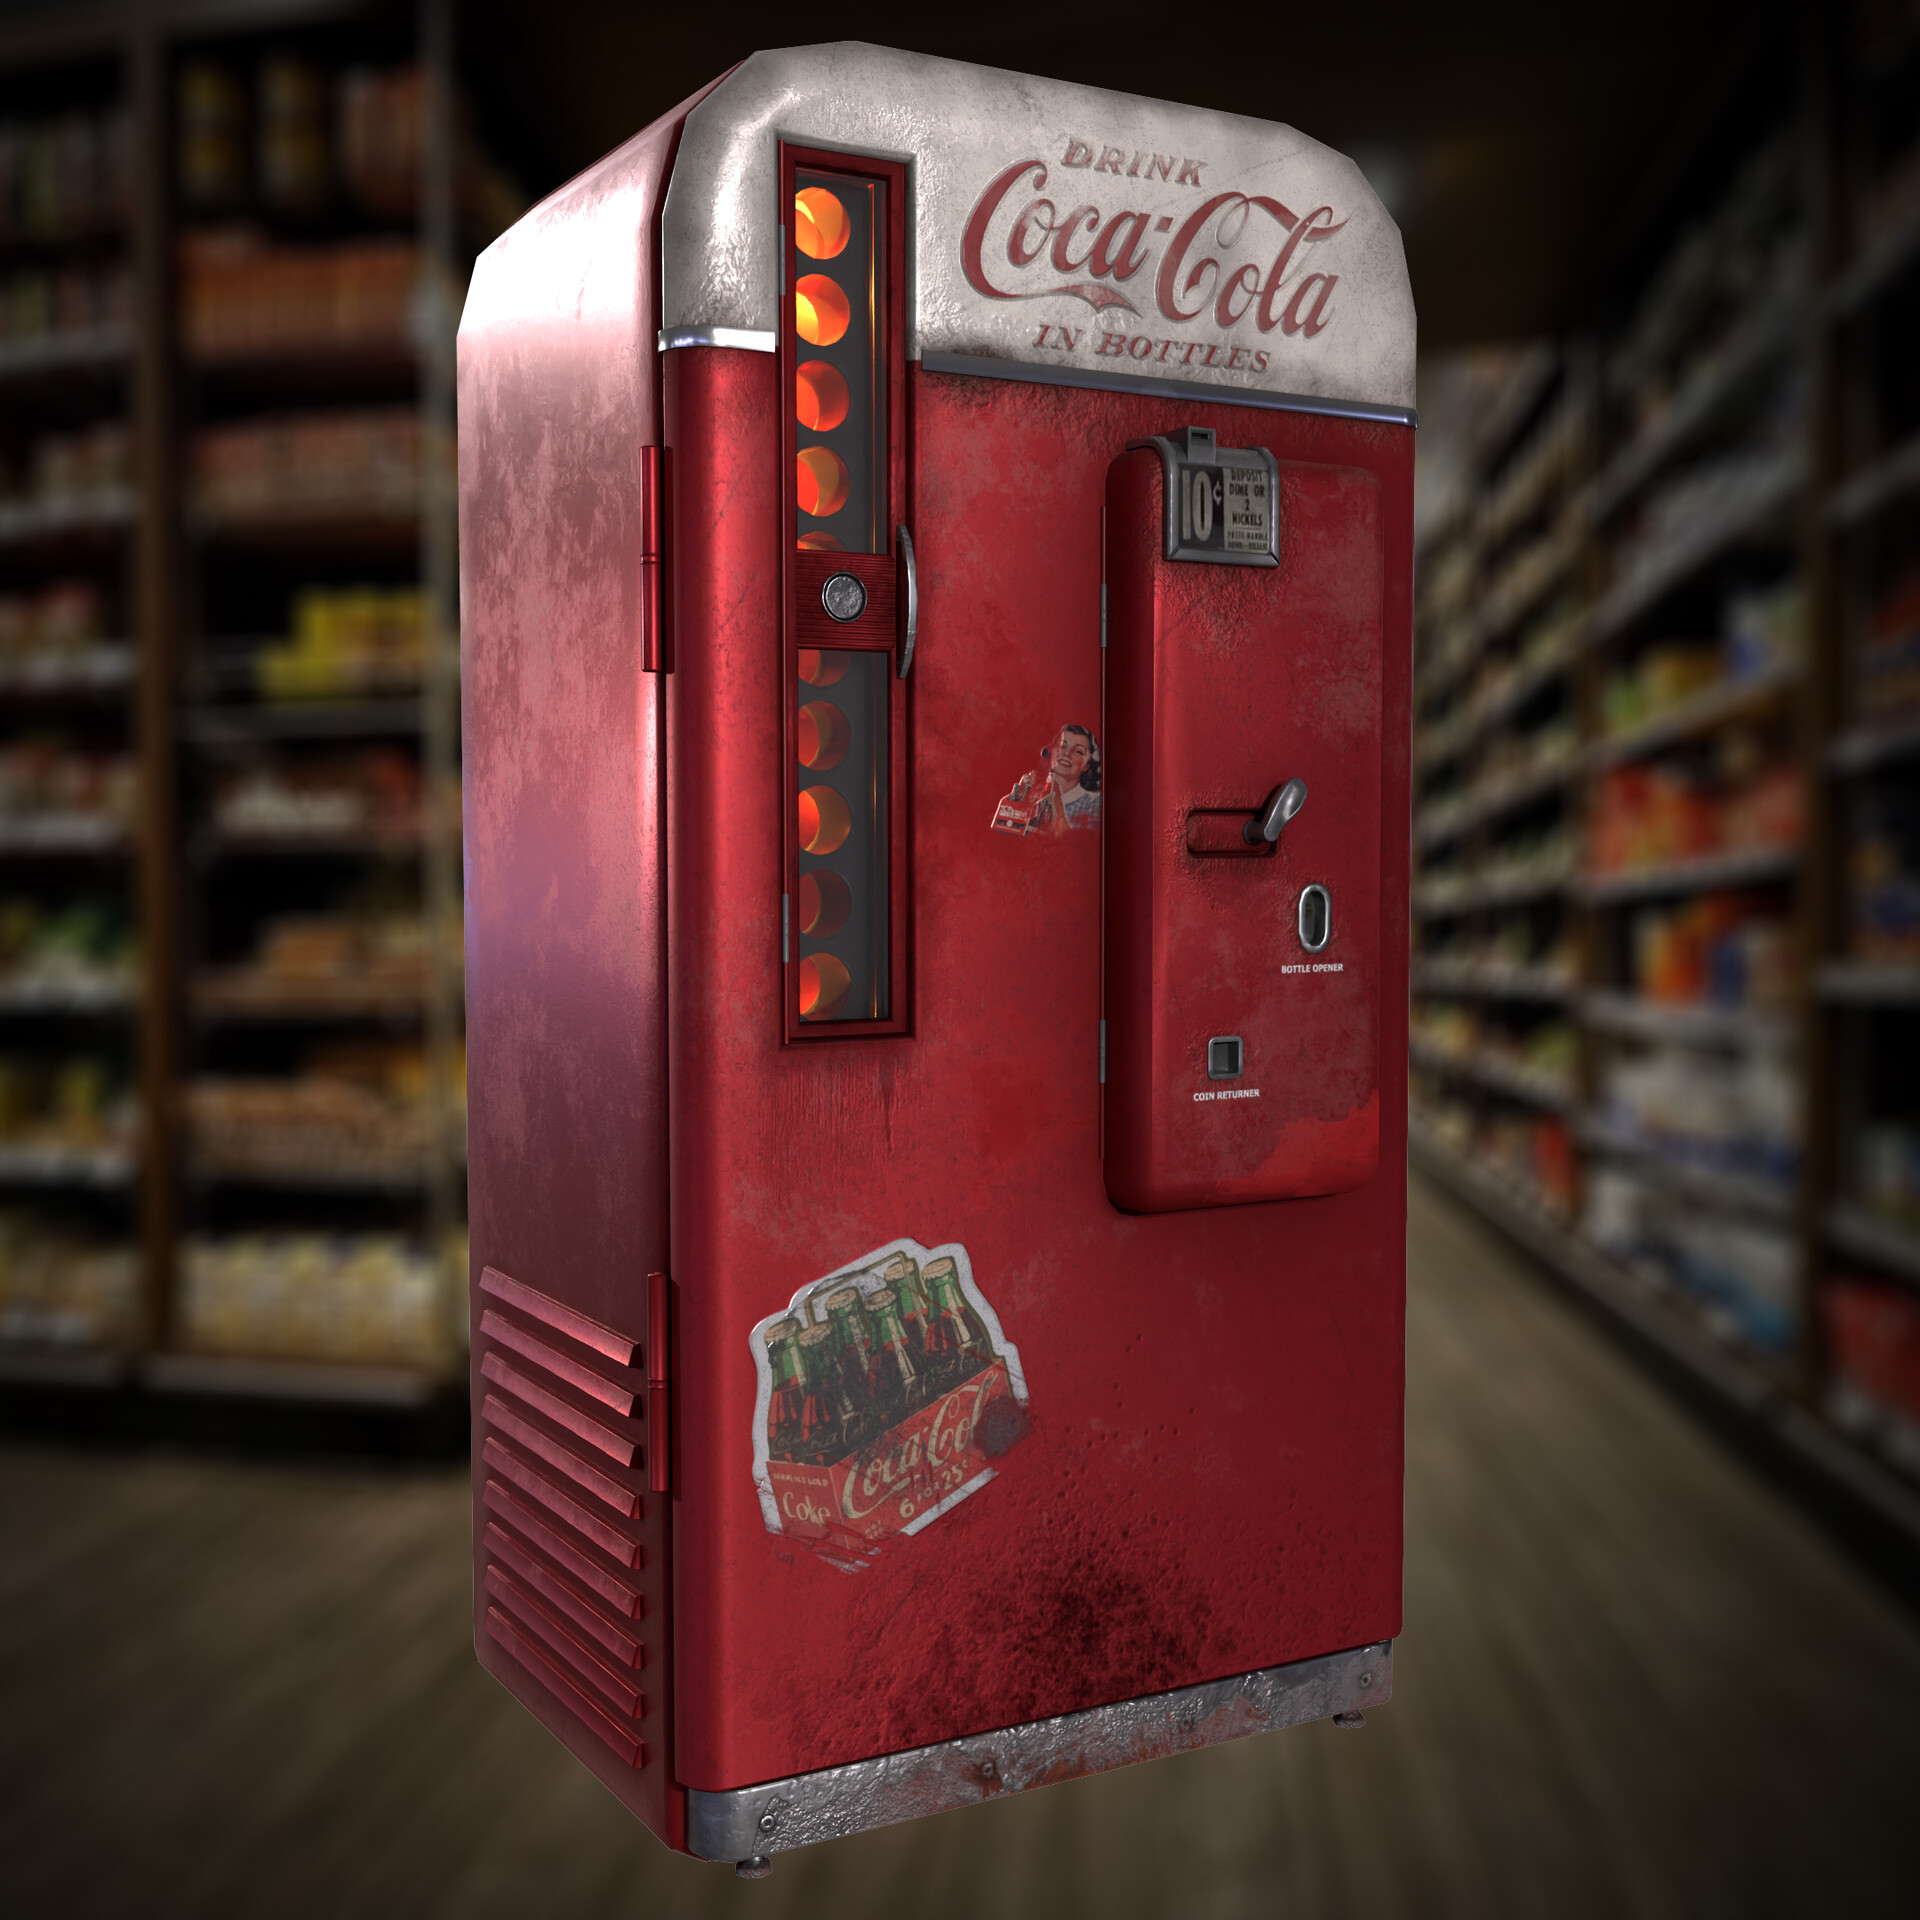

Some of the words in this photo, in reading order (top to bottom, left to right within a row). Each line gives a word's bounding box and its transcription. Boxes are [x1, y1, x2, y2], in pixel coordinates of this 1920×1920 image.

[1060, 138, 1208, 187] DRINK
[960, 159, 1356, 339] Coca-Cola
[1032, 324, 1083, 352] IN
[1095, 330, 1272, 374] BOTTLES
[1231, 468, 1263, 482] DEPOSIT
[1229, 483, 1249, 497] DIME
[1253, 484, 1266, 498] OR
[1244, 498, 1250, 511] 2
[1232, 512, 1262, 526] NICKELS
[1281, 964, 1310, 973] BOTTLE
[1312, 963, 1343, 972] OPENER
[1193, 1091, 1215, 1102] COIN
[1217, 1089, 1260, 1100] RETURNER
[842, 1370, 998, 1519] Coca-Col
[782, 1491, 831, 1525] Coke
[899, 1498, 915, 1519] 6
